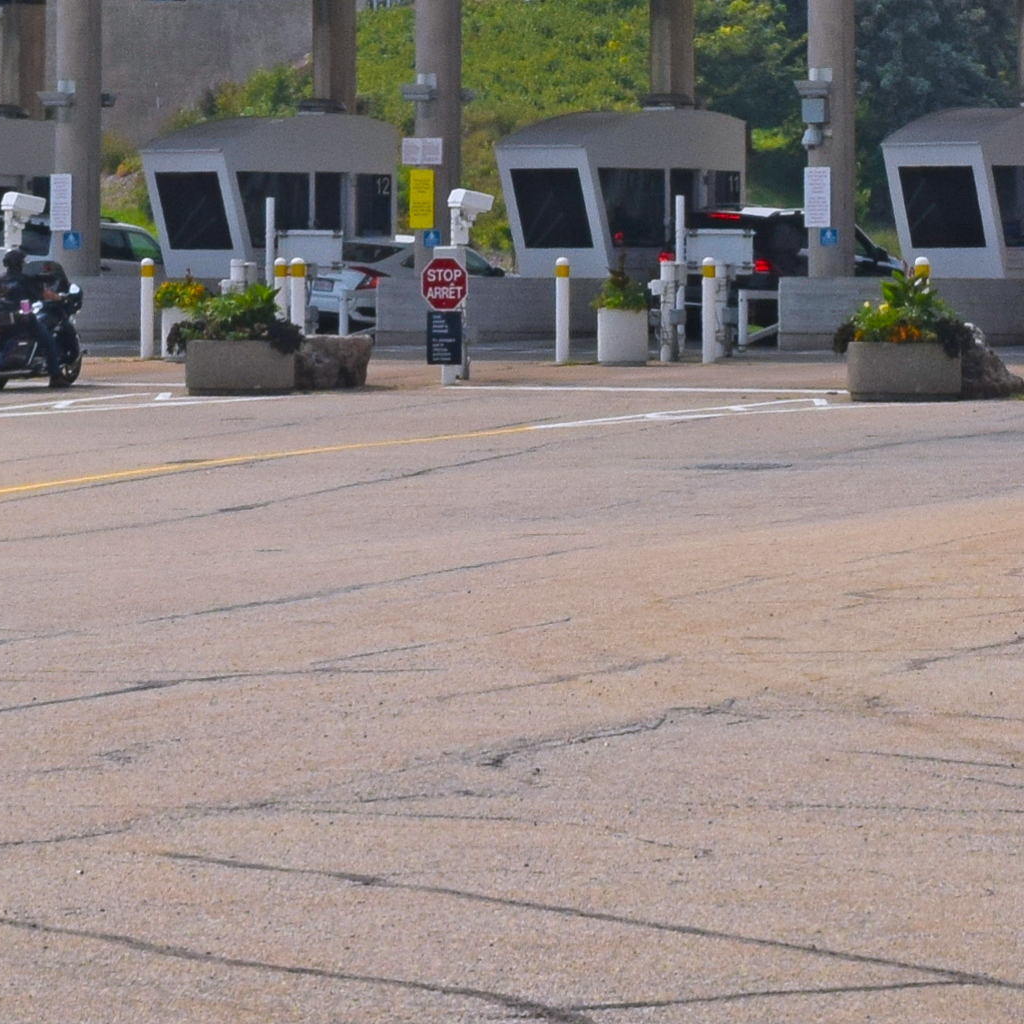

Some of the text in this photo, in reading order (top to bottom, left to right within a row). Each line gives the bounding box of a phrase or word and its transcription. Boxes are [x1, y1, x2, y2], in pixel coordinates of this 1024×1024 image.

[376, 177, 390, 195] 12
[427, 269, 462, 282] STOP
[427, 283, 463, 299] ARRÊT
